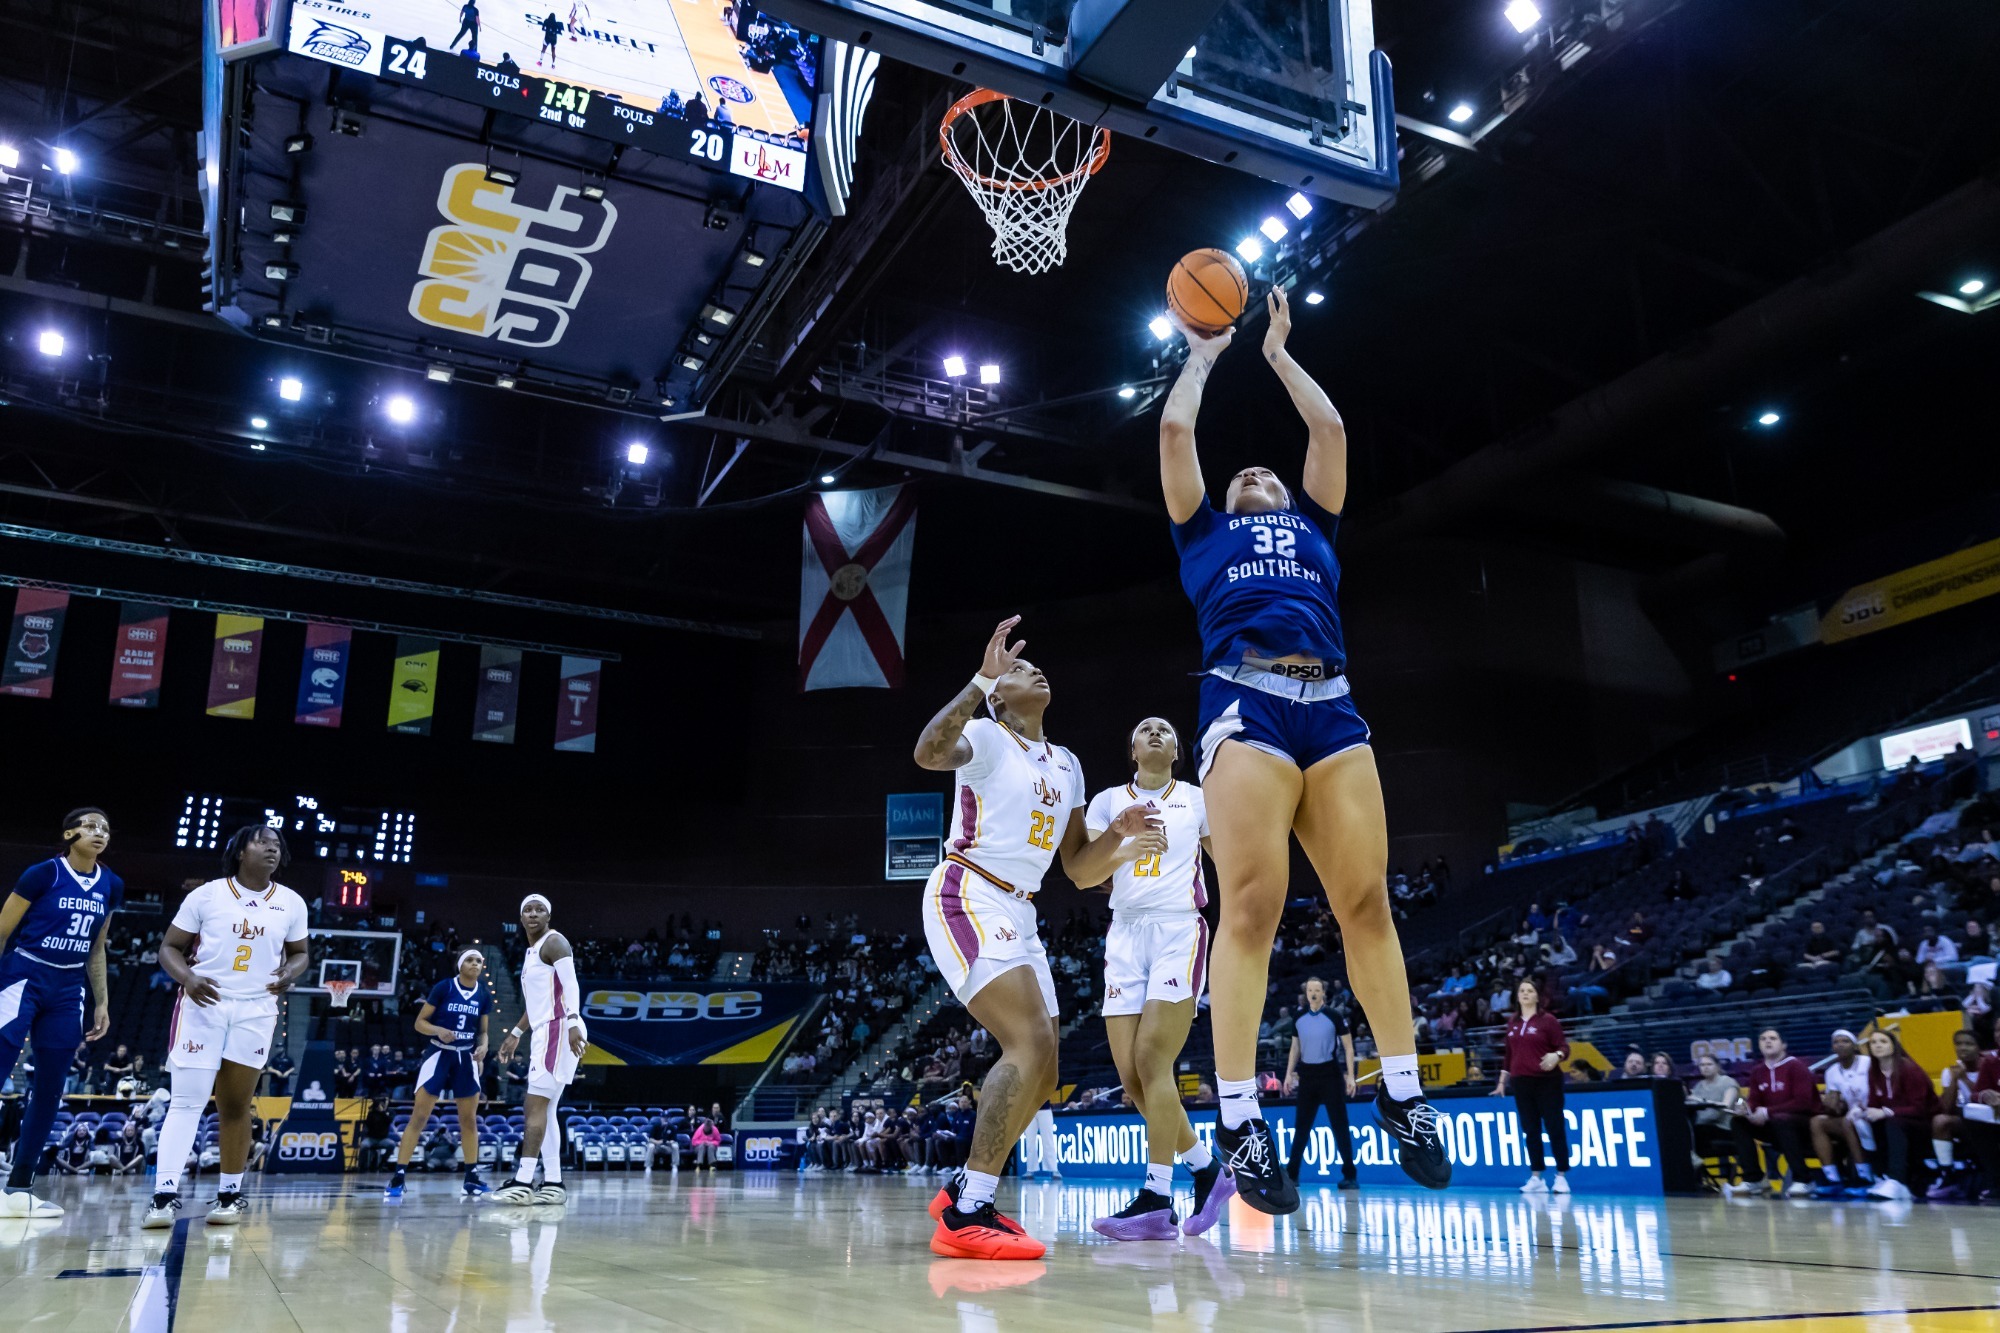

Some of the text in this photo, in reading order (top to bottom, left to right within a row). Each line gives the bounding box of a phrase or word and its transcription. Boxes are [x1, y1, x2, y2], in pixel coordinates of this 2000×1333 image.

[326, 5, 371, 19] TIRES
[388, 44, 427, 80] 24
[477, 67, 520, 89] FOULS
[492, 86, 501, 97] 0
[544, 81, 590, 115] 7:47
[540, 106, 587, 129] 2nd Qtr
[613, 105, 654, 126] FOULS
[626, 122, 634, 134] 0
[689, 129, 724, 162] 20
[1229, 514, 1312, 534] GEORGIA
[1250, 526, 1297, 559] 32
[1286, 664, 1322, 679] PSD
[1033, 776, 1062, 807] ULM
[266, 815, 284, 829] 20
[318, 819, 336, 832] 24
[892, 805, 935, 826] DASANI
[1027, 809, 1055, 851] 22
[340, 870, 367, 885] 7:46
[342, 885, 362, 906] 11
[58, 897, 105, 916] GEORGIA
[66, 912, 95, 938] 30
[232, 917, 266, 941] ULM
[232, 944, 253, 973] 2
[447, 1002, 479, 1017] GEORGIA
[582, 989, 762, 1022] SBC
[456, 1014, 467, 1030] 3
[182, 1039, 204, 1053] ULM
[278, 1132, 338, 1161] SBC
[1562, 1106, 1651, 1168] CAFE
[744, 1136, 783, 1161] SBC
